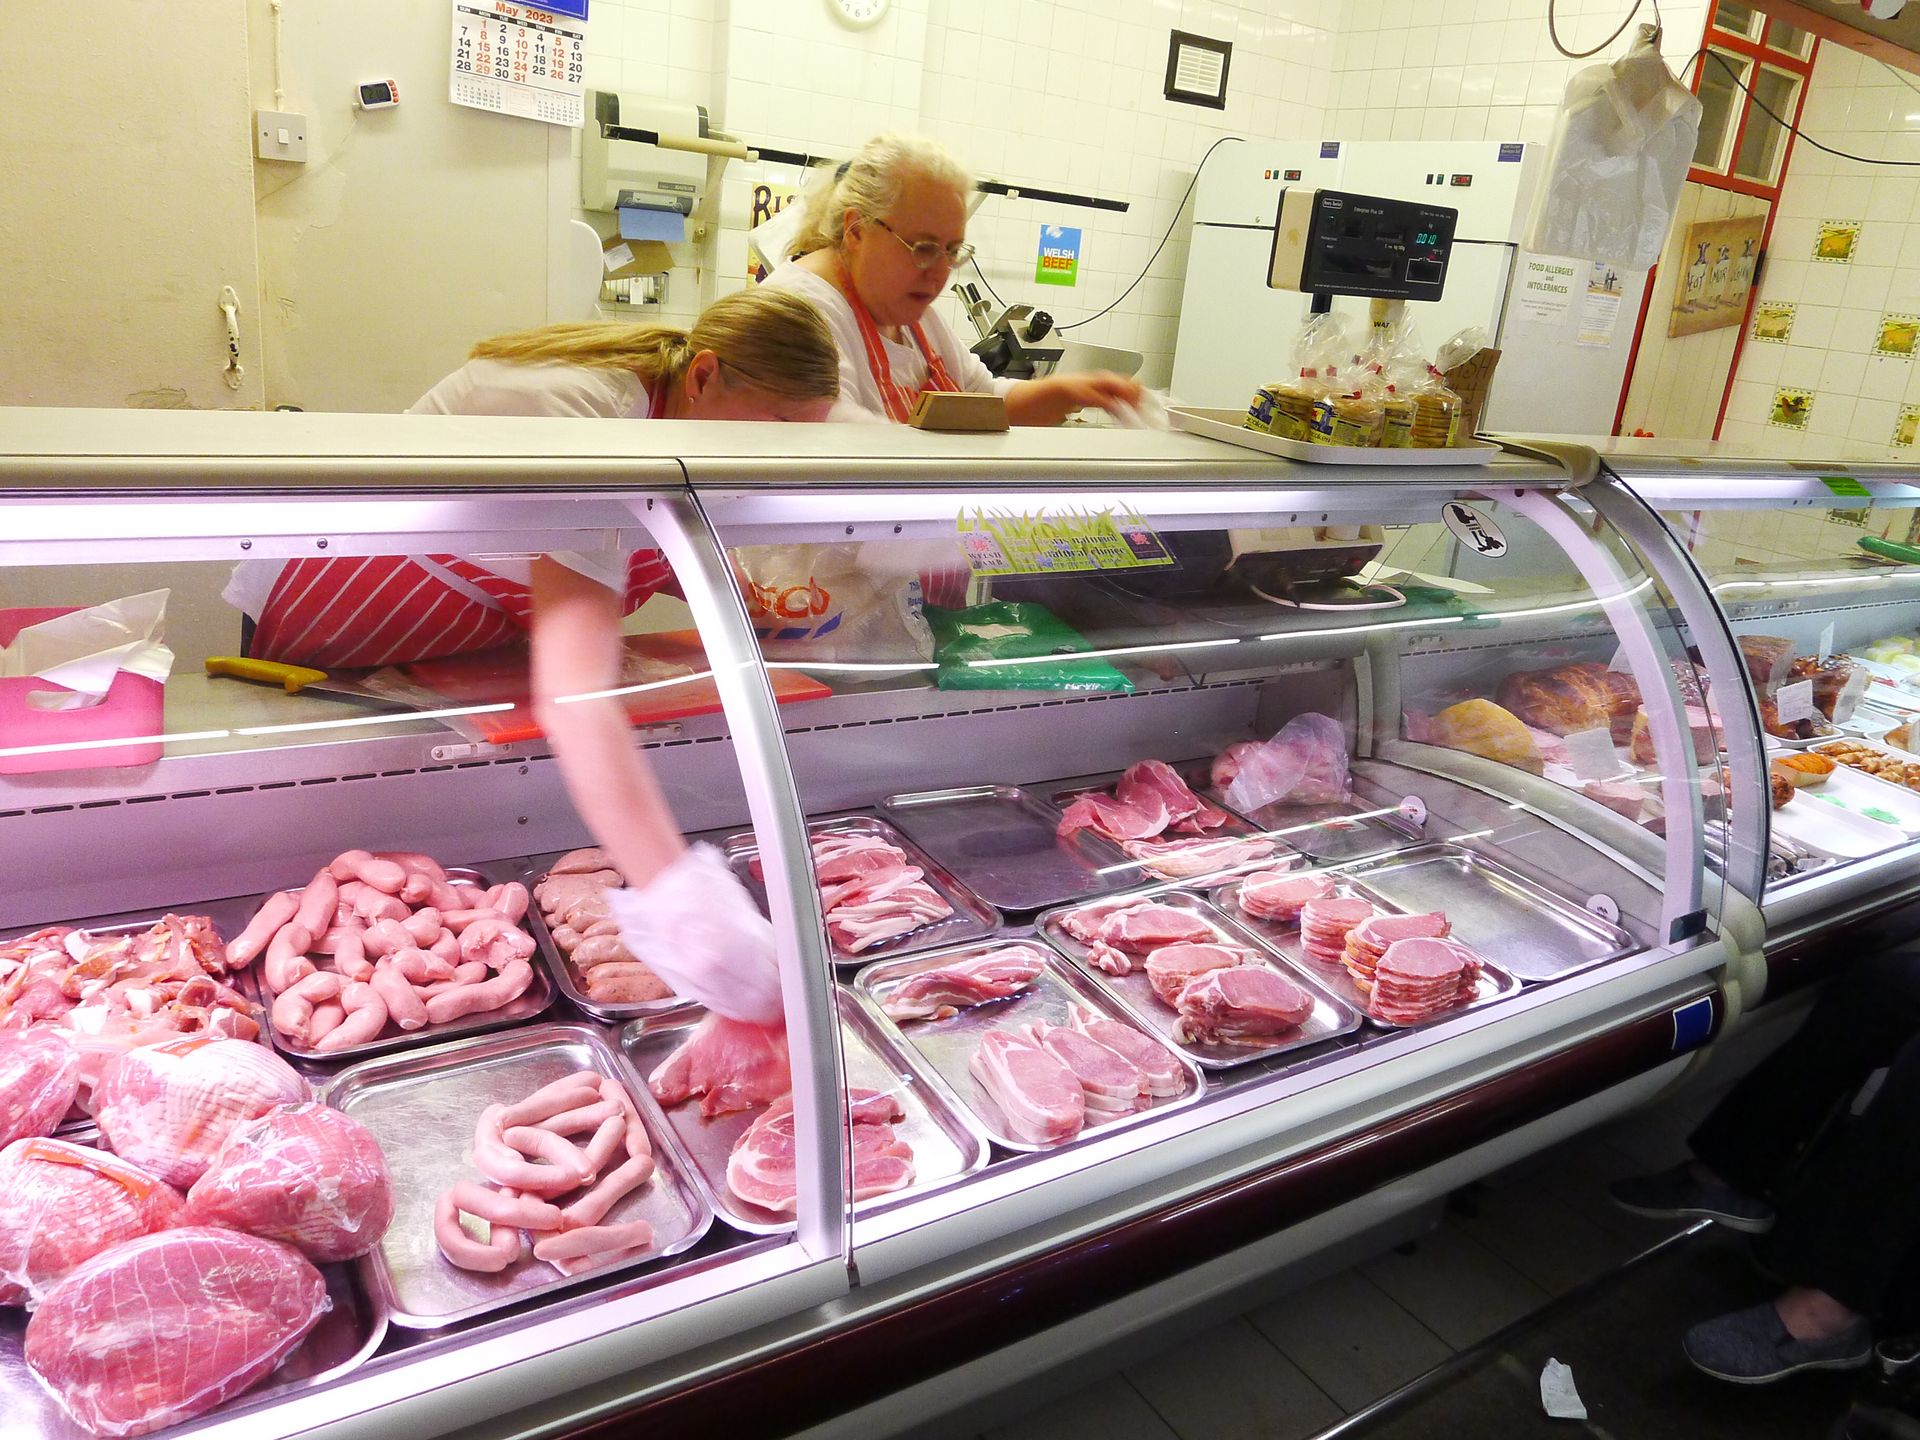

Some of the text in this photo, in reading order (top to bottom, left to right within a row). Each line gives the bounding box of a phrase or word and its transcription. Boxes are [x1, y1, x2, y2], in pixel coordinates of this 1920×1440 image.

[496, 2, 553, 24] May 2023
[854, 9, 860, 18] 6
[462, 26, 582, 62] 7 8 9 10 11 12 13
[482, 20, 580, 50] 1 2 3 4 5 6
[457, 49, 582, 83] 21 22 23 24 25 26 27
[458, 38, 582, 72] 14 15 16 17 18 19 20
[457, 60, 526, 82] 28 29 30 31
[1042, 256, 1073, 270] BEEF
[1044, 247, 1074, 259] WELSH
[1528, 262, 1574, 276] FOOD ALLERGIES
[1527, 282, 1568, 294] INTOLERANCES
